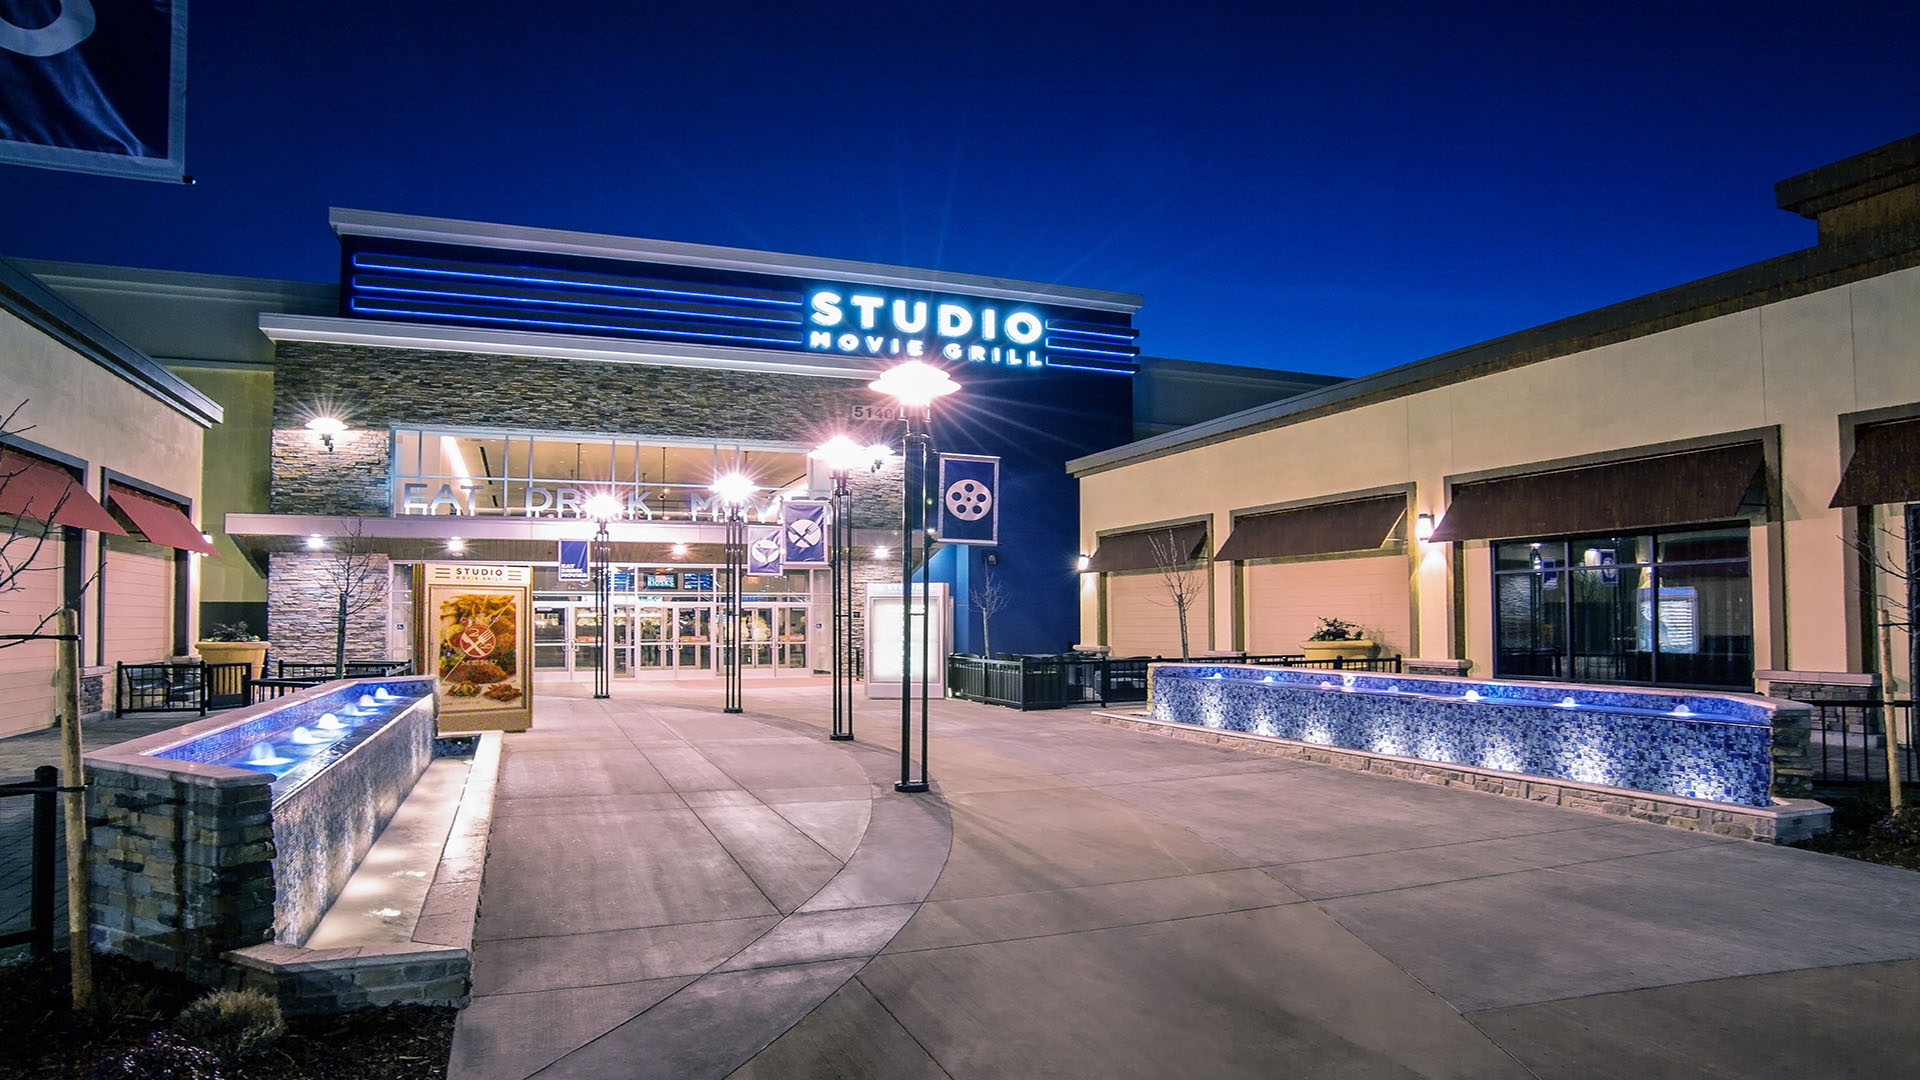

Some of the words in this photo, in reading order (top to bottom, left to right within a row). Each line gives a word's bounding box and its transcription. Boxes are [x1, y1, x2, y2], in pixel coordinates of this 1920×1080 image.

[811, 291, 1043, 344] STUDIO
[810, 331, 924, 357] MOVIE
[944, 343, 1043, 366] GRILL
[854, 406, 893, 419] 5140
[404, 483, 484, 512] EAT
[525, 487, 653, 517] DRK
[456, 567, 503, 577] STUDIO
